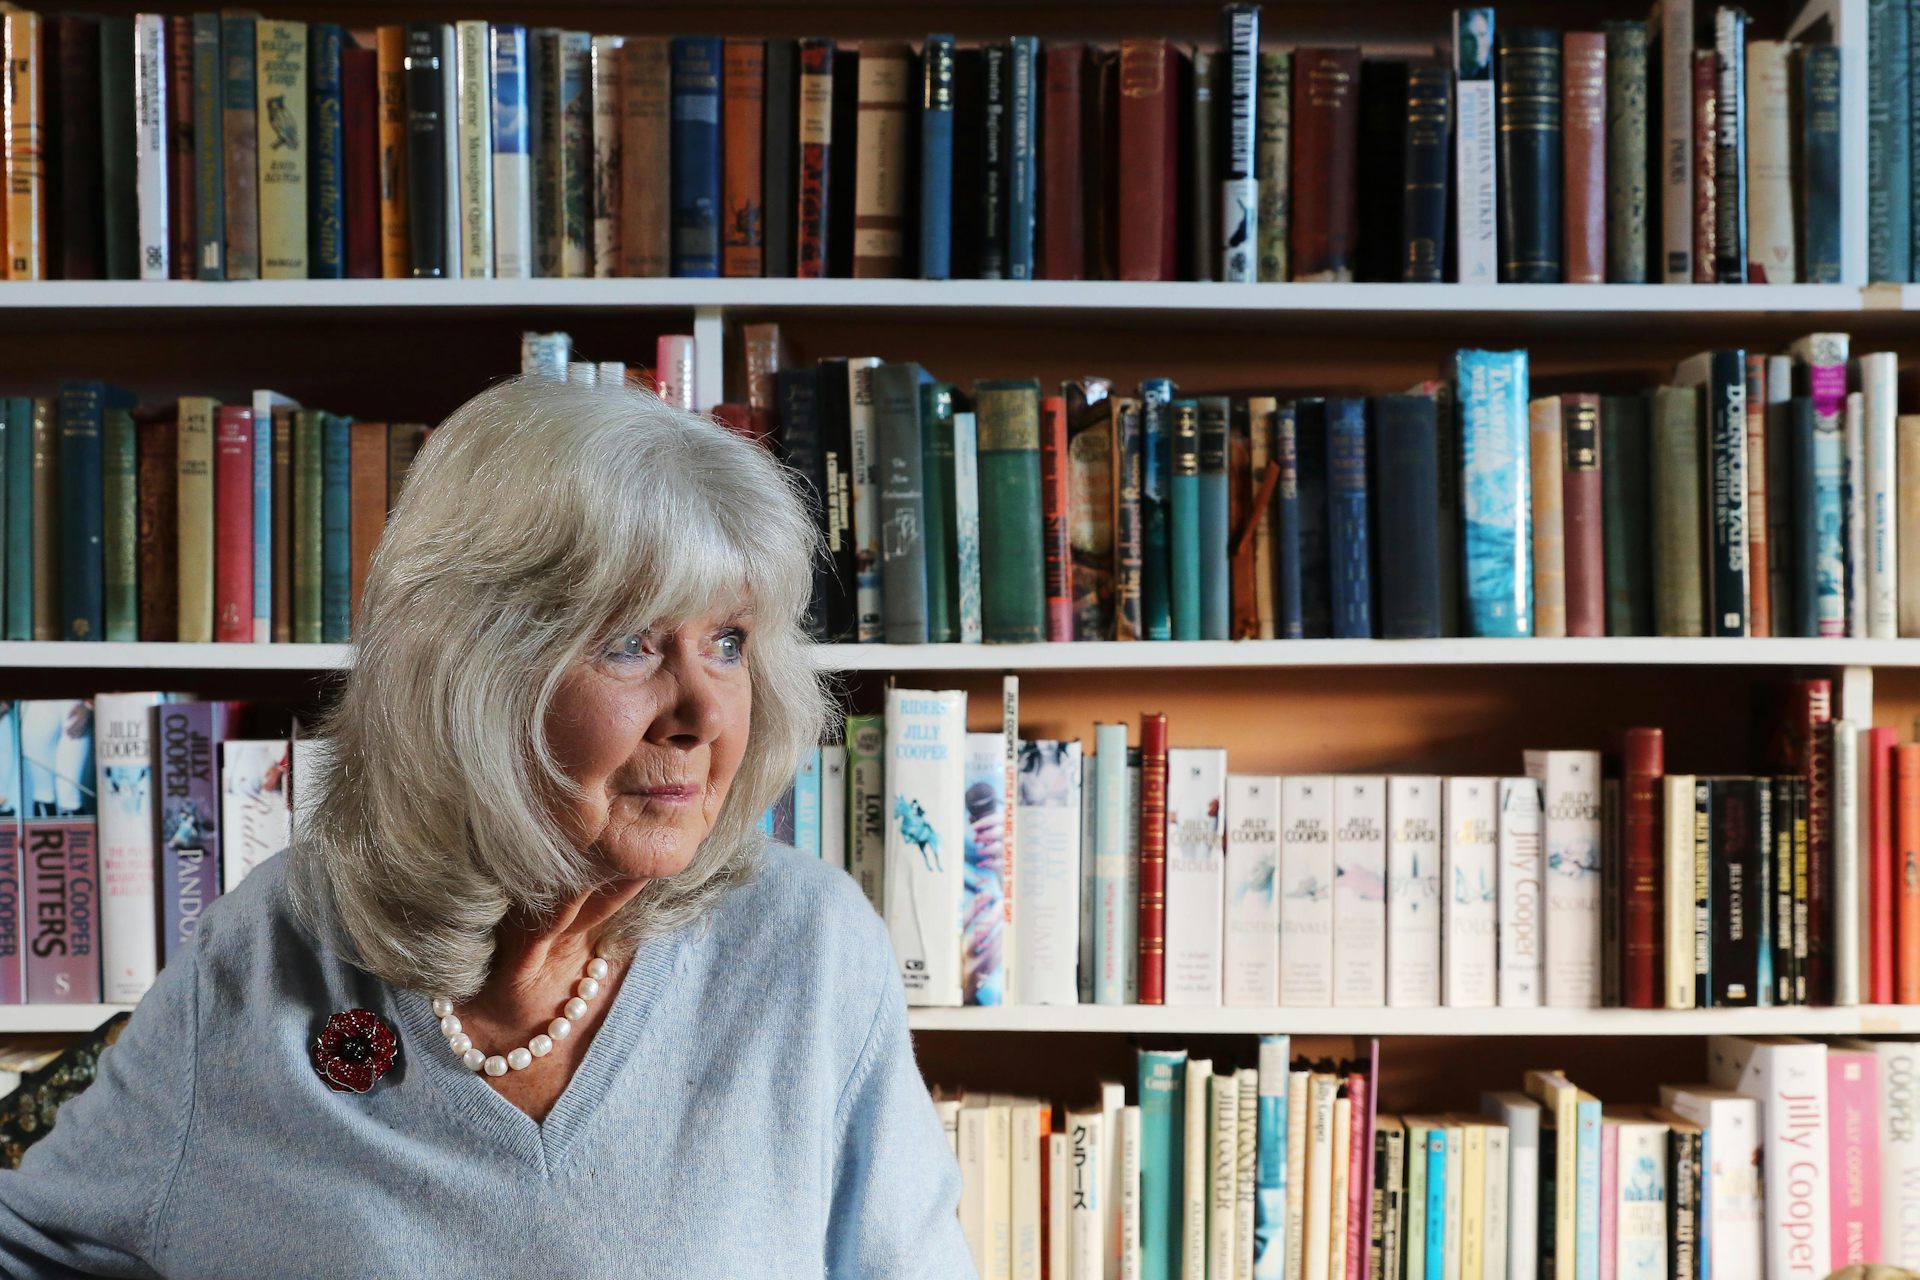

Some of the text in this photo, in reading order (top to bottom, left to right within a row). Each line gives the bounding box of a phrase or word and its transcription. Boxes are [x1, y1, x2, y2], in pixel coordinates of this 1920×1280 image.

[465, 25, 482, 257] Graham Greene Monsignor Quixote
[1477, 87, 1493, 173] JONATHAN
[1727, 384, 1745, 572] DORNFORD YATES
[107, 720, 143, 739] JILLY
[900, 699, 946, 715] RIDERS
[904, 724, 940, 741] JILLY
[164, 713, 189, 798] COOPER
[190, 731, 209, 783] JILLY
[895, 744, 948, 760] COOPER
[865, 793, 881, 838] LOVE
[1231, 830, 1276, 843] COOPER
[1241, 818, 1268, 829] JILLY
[1285, 830, 1330, 843] COOPER
[1295, 818, 1321, 829] JILLY
[1338, 828, 1381, 842] COOPER
[1347, 817, 1374, 828] JILLY
[1509, 829, 1540, 872] Jilly
[0, 877, 19, 957] COOPER
[29, 828, 67, 959] RUITERS
[67, 829, 93, 957] JILLY COOPER
[177, 848, 204, 942] PANDO
[1509, 878, 1541, 958] Cooper
[1238, 1079, 1257, 1122] JILLY
[1889, 1055, 1914, 1143] COOPER
[1073, 1125, 1088, 1211] クラース
[1216, 1090, 1234, 1209] JILLY COOPER
[1779, 1091, 1822, 1273] Jilly Cooper
